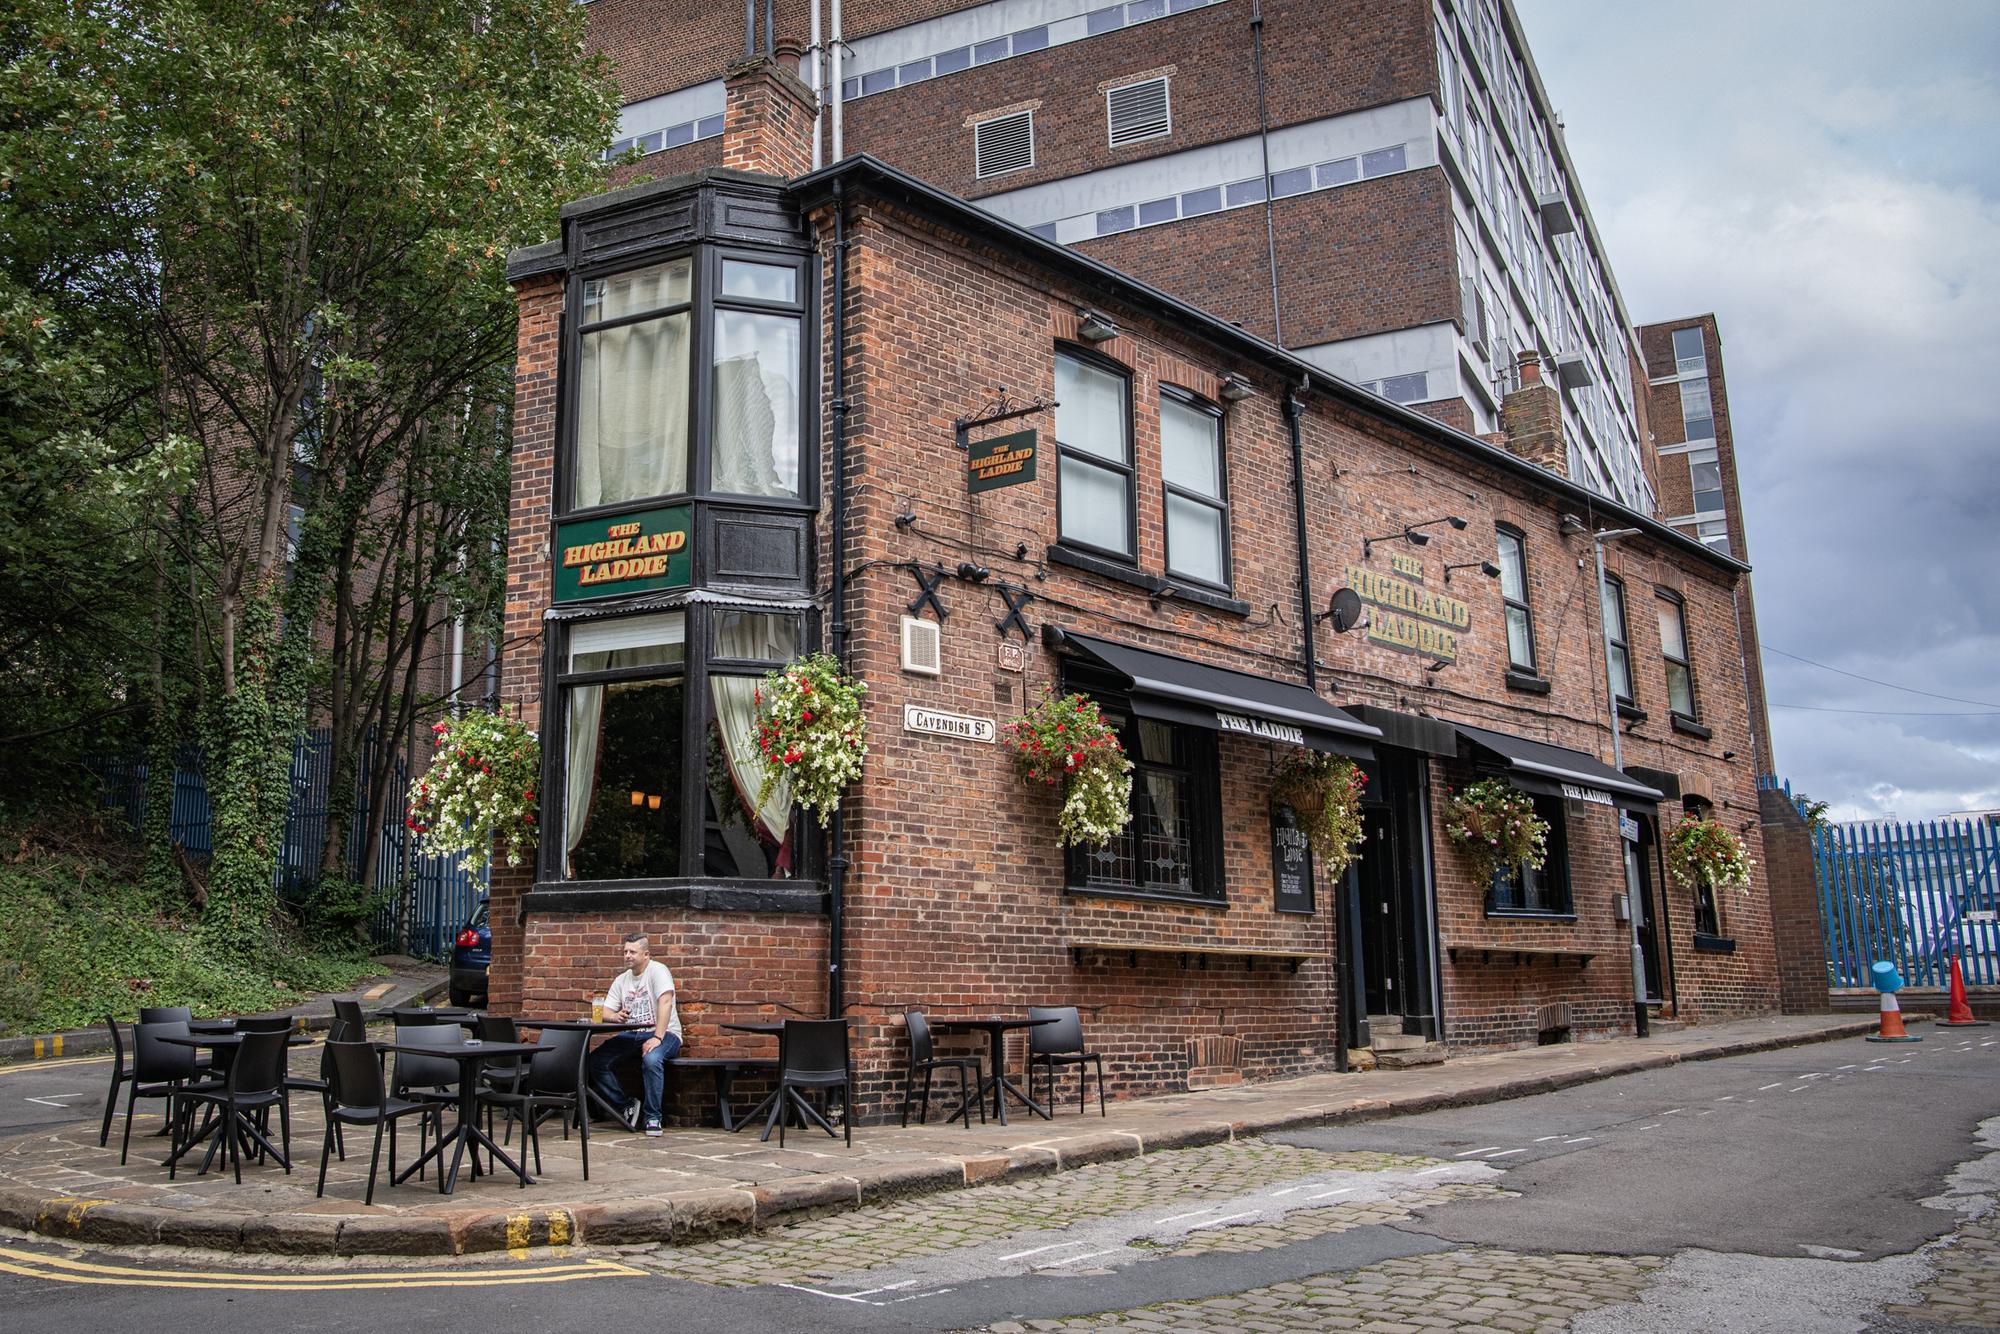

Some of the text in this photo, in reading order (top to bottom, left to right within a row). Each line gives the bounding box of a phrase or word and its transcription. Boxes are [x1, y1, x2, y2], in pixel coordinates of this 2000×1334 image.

[969, 447, 1034, 471] HIGHLAND
[992, 445, 1010, 456] THE
[978, 460, 1024, 480] LADDIE
[608, 522, 641, 539] THE
[563, 530, 687, 568] HIGHLAND
[578, 554, 669, 586] LADDIE
[1391, 551, 1424, 581] THE
[1344, 563, 1471, 632] HIGHLAND
[1367, 606, 1457, 662] LADDIE
[916, 712, 970, 735] CAVENDISH
[1216, 712, 1304, 744] THE LADDIE
[1561, 784, 1613, 806] THE LADDIE
